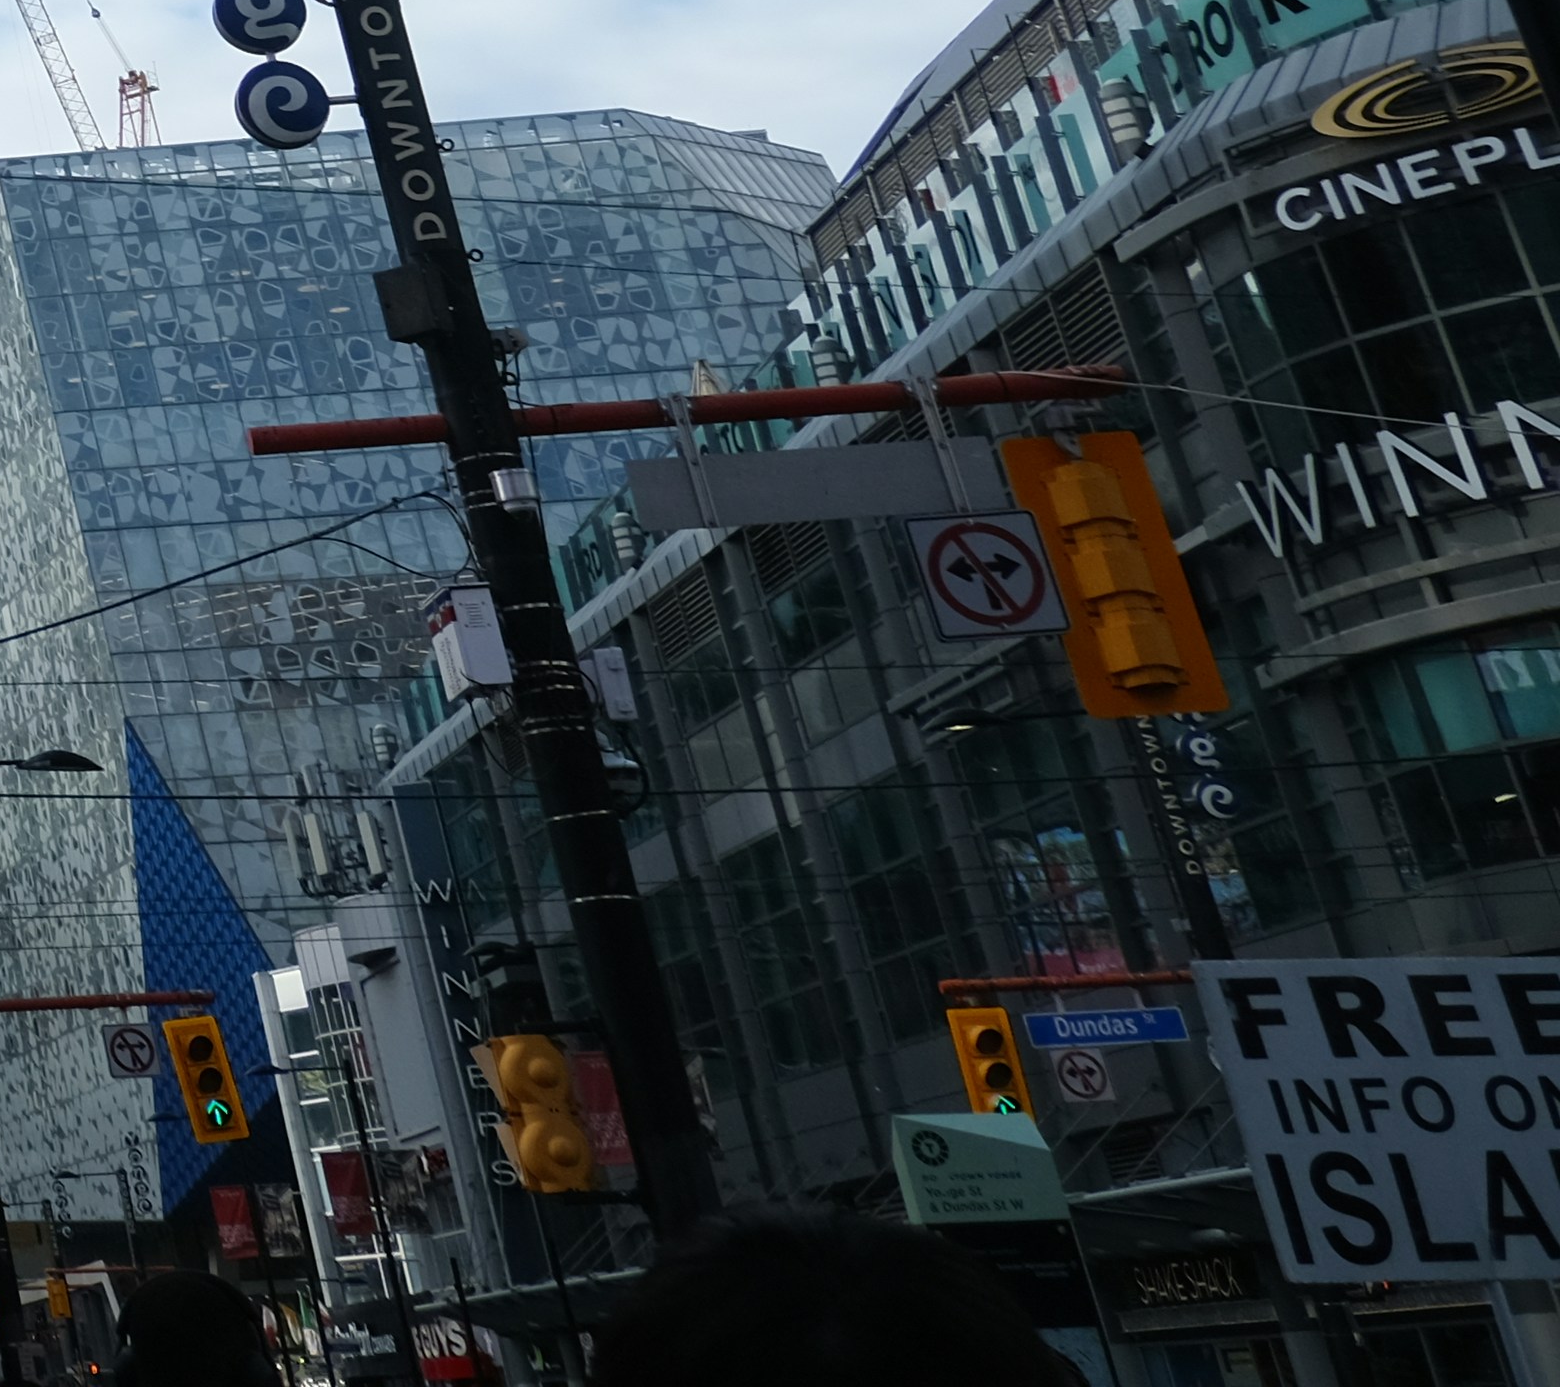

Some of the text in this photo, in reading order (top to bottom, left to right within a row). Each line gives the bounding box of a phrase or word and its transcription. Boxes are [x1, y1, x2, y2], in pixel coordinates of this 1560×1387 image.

[1055, 1012, 1156, 1039] Dundas St
[1218, 973, 1560, 1060] FREE
[1267, 1075, 1456, 1134] INFO
[1265, 1148, 1560, 1266] ISLA
[1133, 1255, 1244, 1306] SHAKE SHACK
